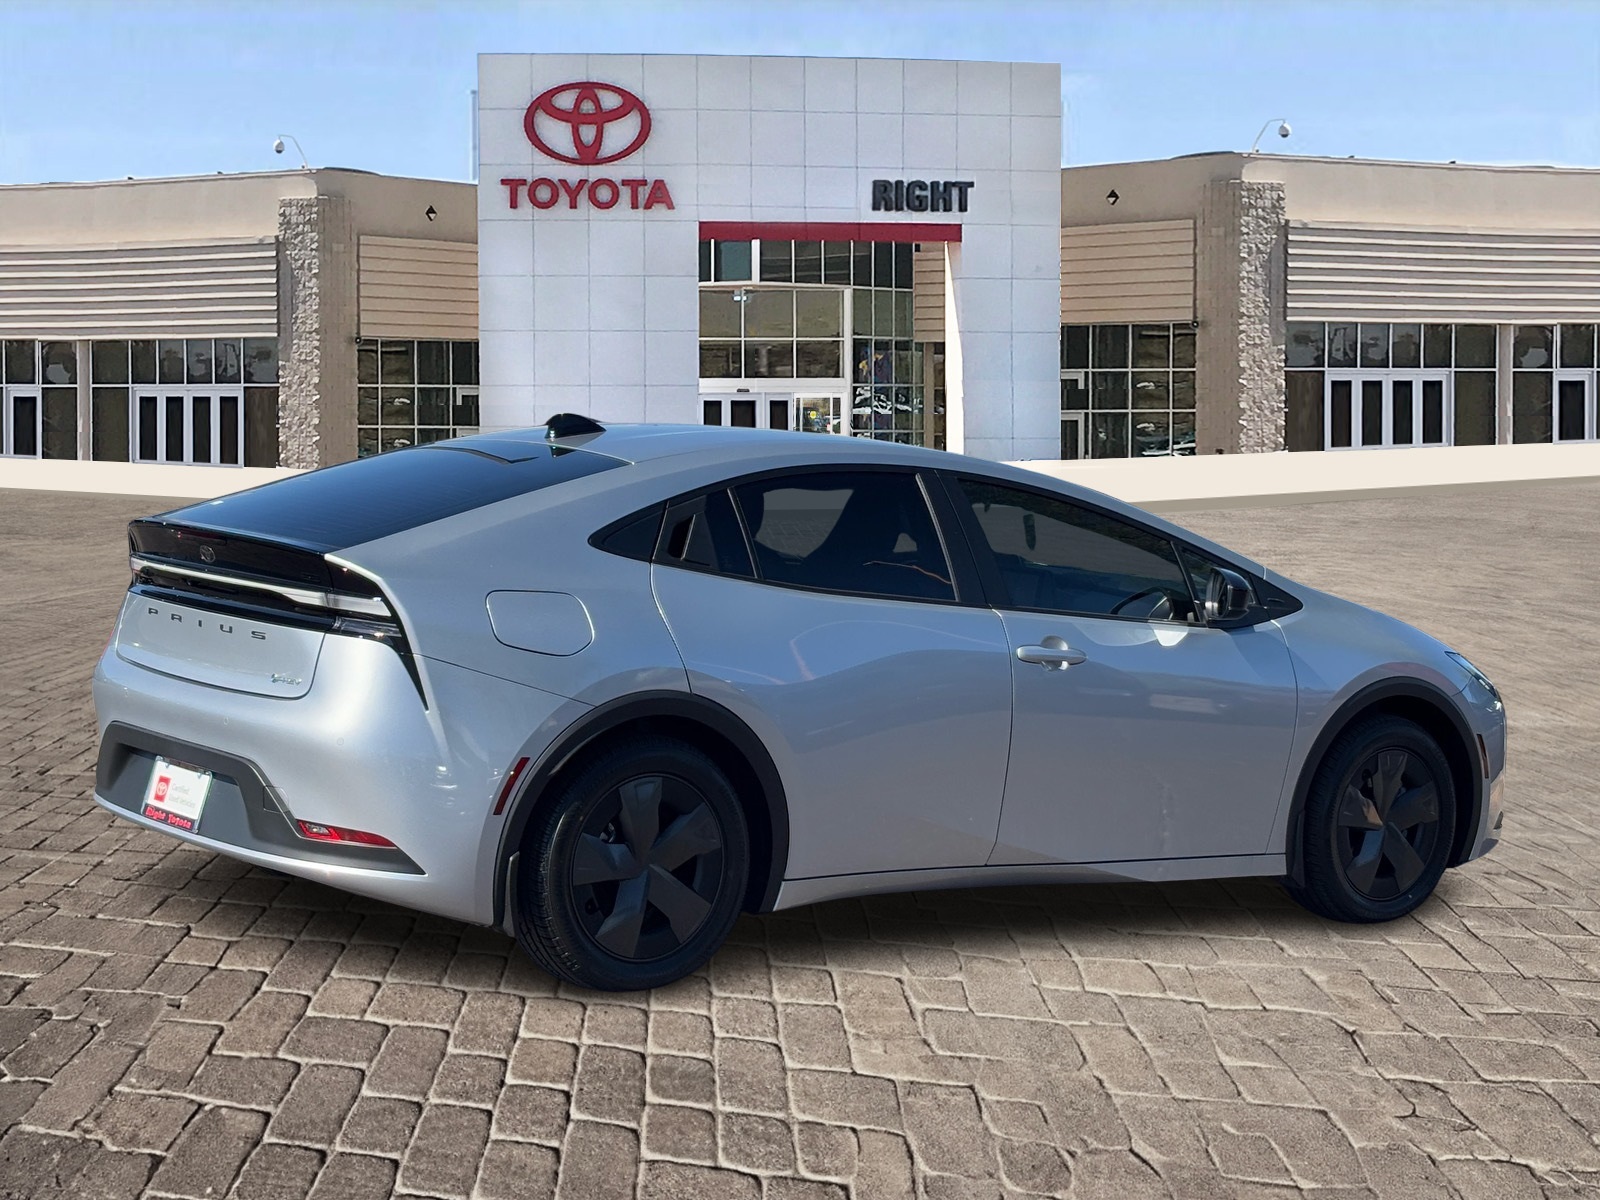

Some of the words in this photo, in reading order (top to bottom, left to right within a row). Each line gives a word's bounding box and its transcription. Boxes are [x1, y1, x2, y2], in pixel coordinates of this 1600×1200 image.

[501, 178, 675, 210] TOYOTA
[872, 180, 975, 213] RIGHT
[148, 607, 267, 640] PRIUS
[146, 806, 166, 820] Right
[168, 814, 191, 828] Toyota
